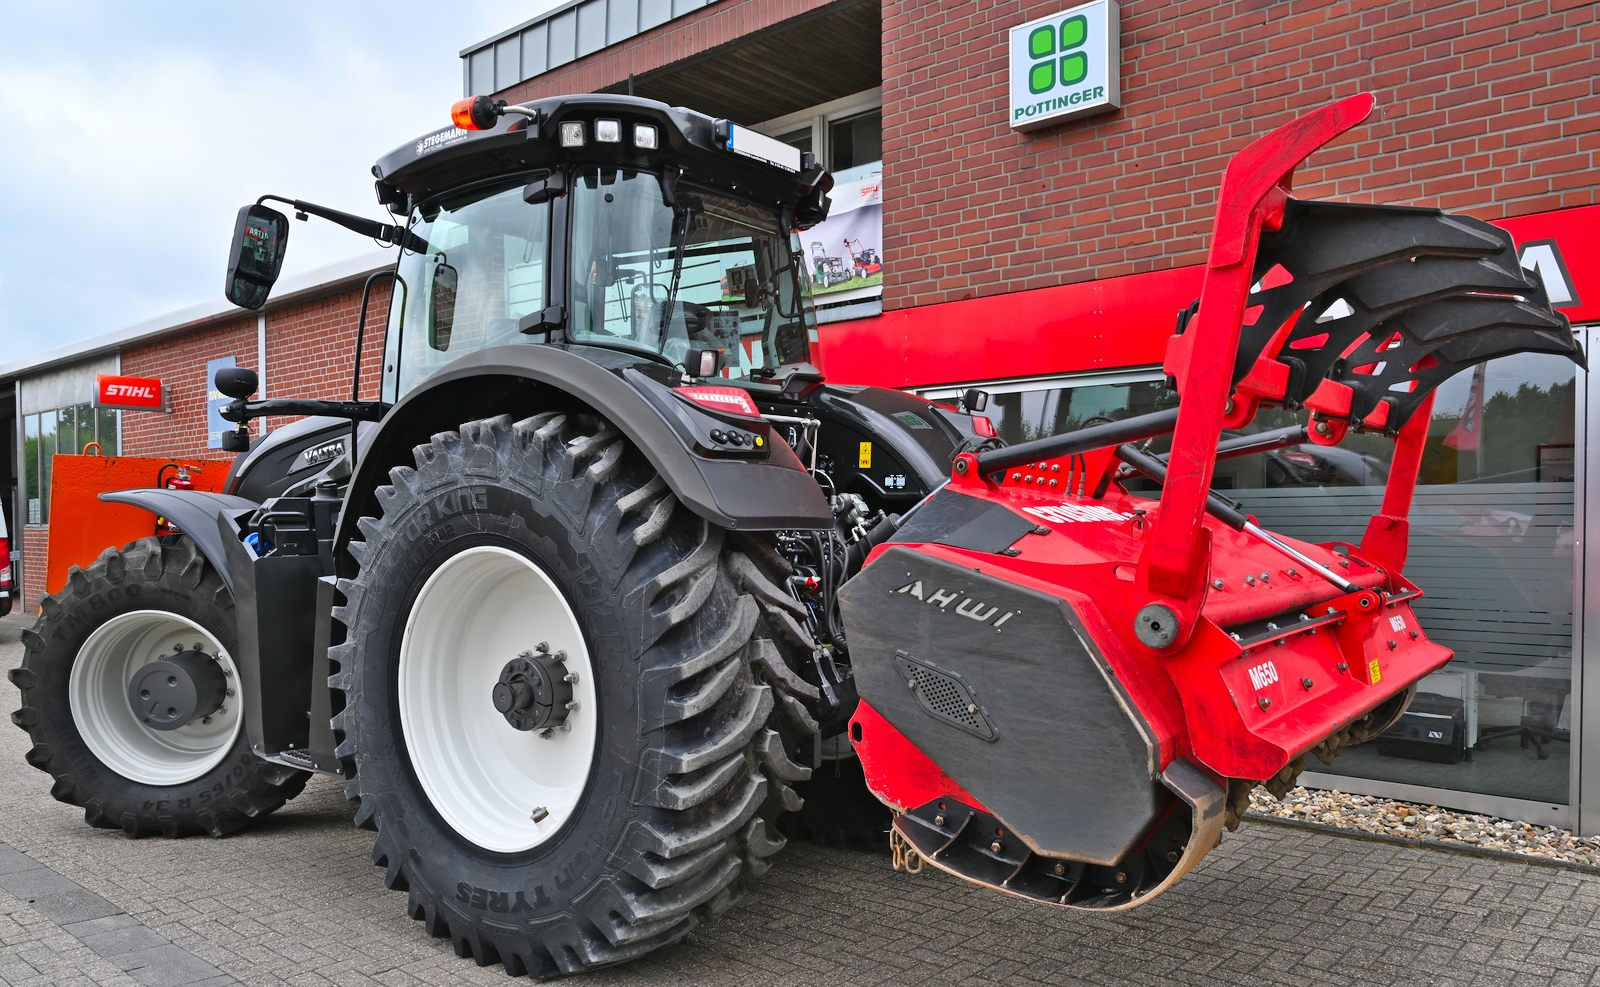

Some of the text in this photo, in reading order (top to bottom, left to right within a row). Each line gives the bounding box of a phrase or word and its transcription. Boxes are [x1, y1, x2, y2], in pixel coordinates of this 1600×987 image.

[1014, 86, 1104, 120] PÖTTINGER
[105, 384, 154, 398] STIHL
[304, 441, 345, 465] VALTRA
[895, 580, 1014, 627] AHWI
[1247, 660, 1279, 691] M650
[455, 880, 551, 914] TYRES
